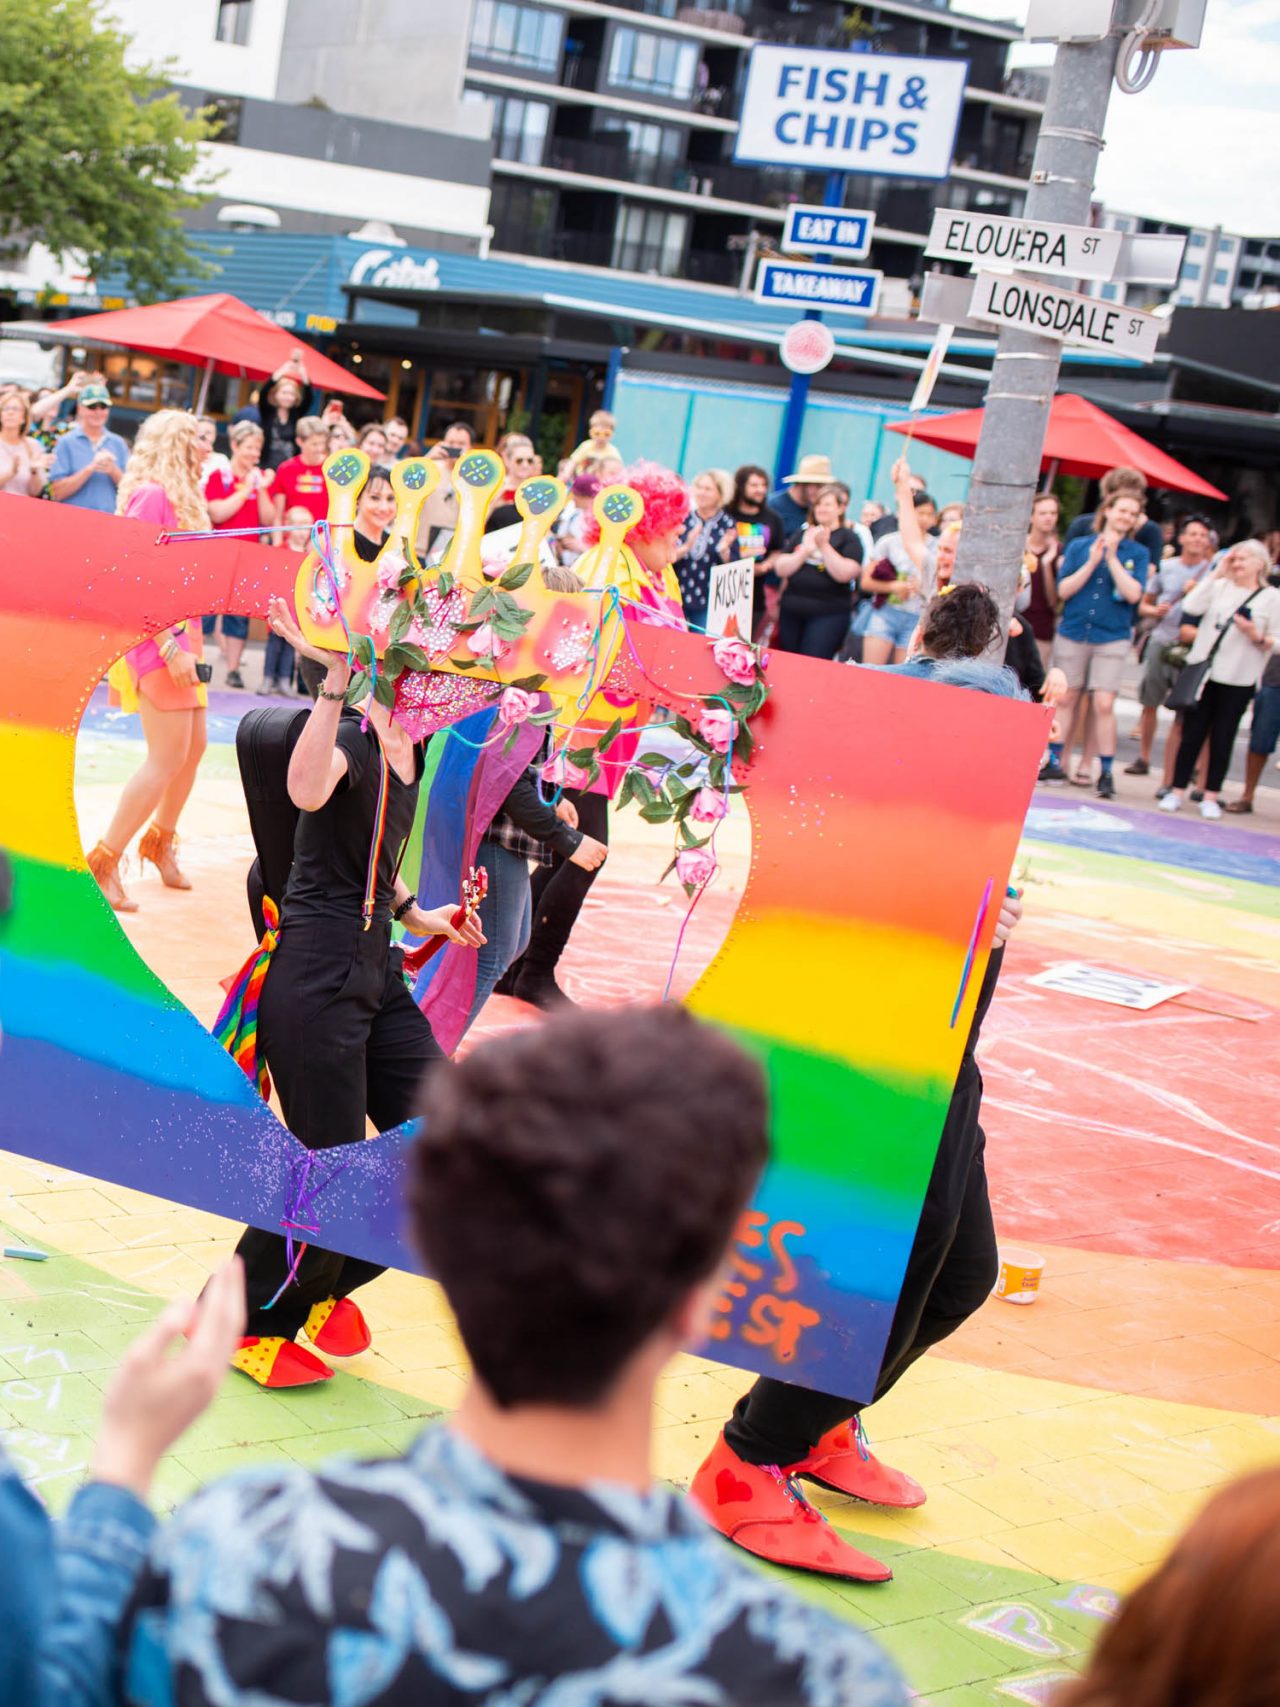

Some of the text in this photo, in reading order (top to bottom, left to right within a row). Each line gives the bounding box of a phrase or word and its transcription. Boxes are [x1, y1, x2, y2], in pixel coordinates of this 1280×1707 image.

[777, 64, 928, 110] FISH &
[774, 111, 918, 155] CHIPS
[797, 216, 861, 245] EAT IN
[945, 220, 1101, 267] ELOUERA ST
[771, 271, 868, 304] TAKEAWAY
[987, 281, 1145, 344] LONSDALE ST
